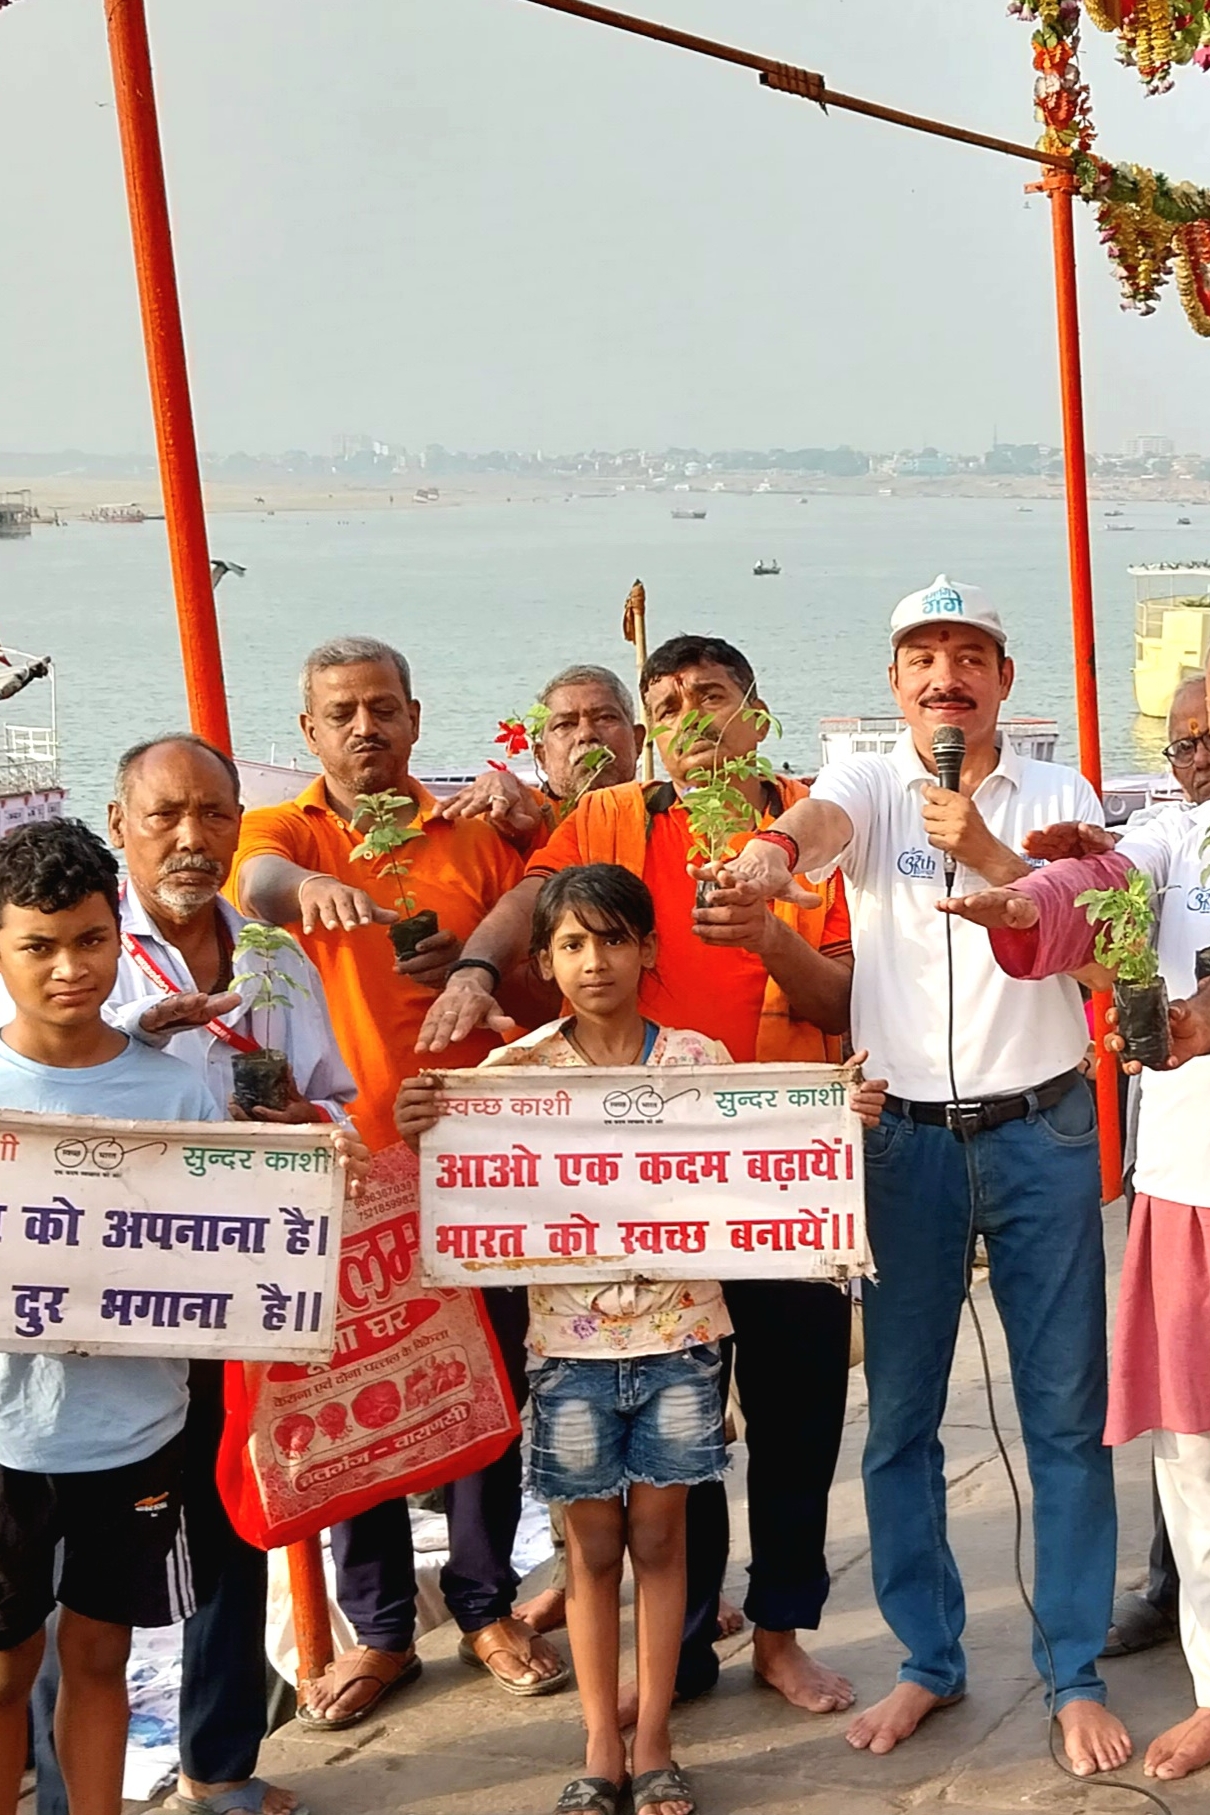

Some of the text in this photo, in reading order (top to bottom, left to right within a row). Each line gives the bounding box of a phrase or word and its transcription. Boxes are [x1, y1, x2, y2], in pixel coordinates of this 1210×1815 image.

[441, 1090, 572, 1117] स्वच्छ काशी
[714, 1082, 847, 1118] सुन्दर काशी
[183, 1146, 332, 1176] सुन्दर काशी
[436, 1144, 541, 1188] आओ
[554, 1152, 623, 1187] एक
[635, 1150, 730, 1184] कदम
[21, 1196, 84, 1247] को
[102, 1209, 270, 1254] अपनाना
[436, 1223, 527, 1258] भारत
[545, 1213, 599, 1256] को
[617, 1220, 710, 1255] स्वच्छ
[12, 1284, 69, 1338] दुर
[101, 1288, 233, 1330] भगाना
[364, 1303, 411, 1338] घर
[393, 1405, 468, 1449] वाराणसी
